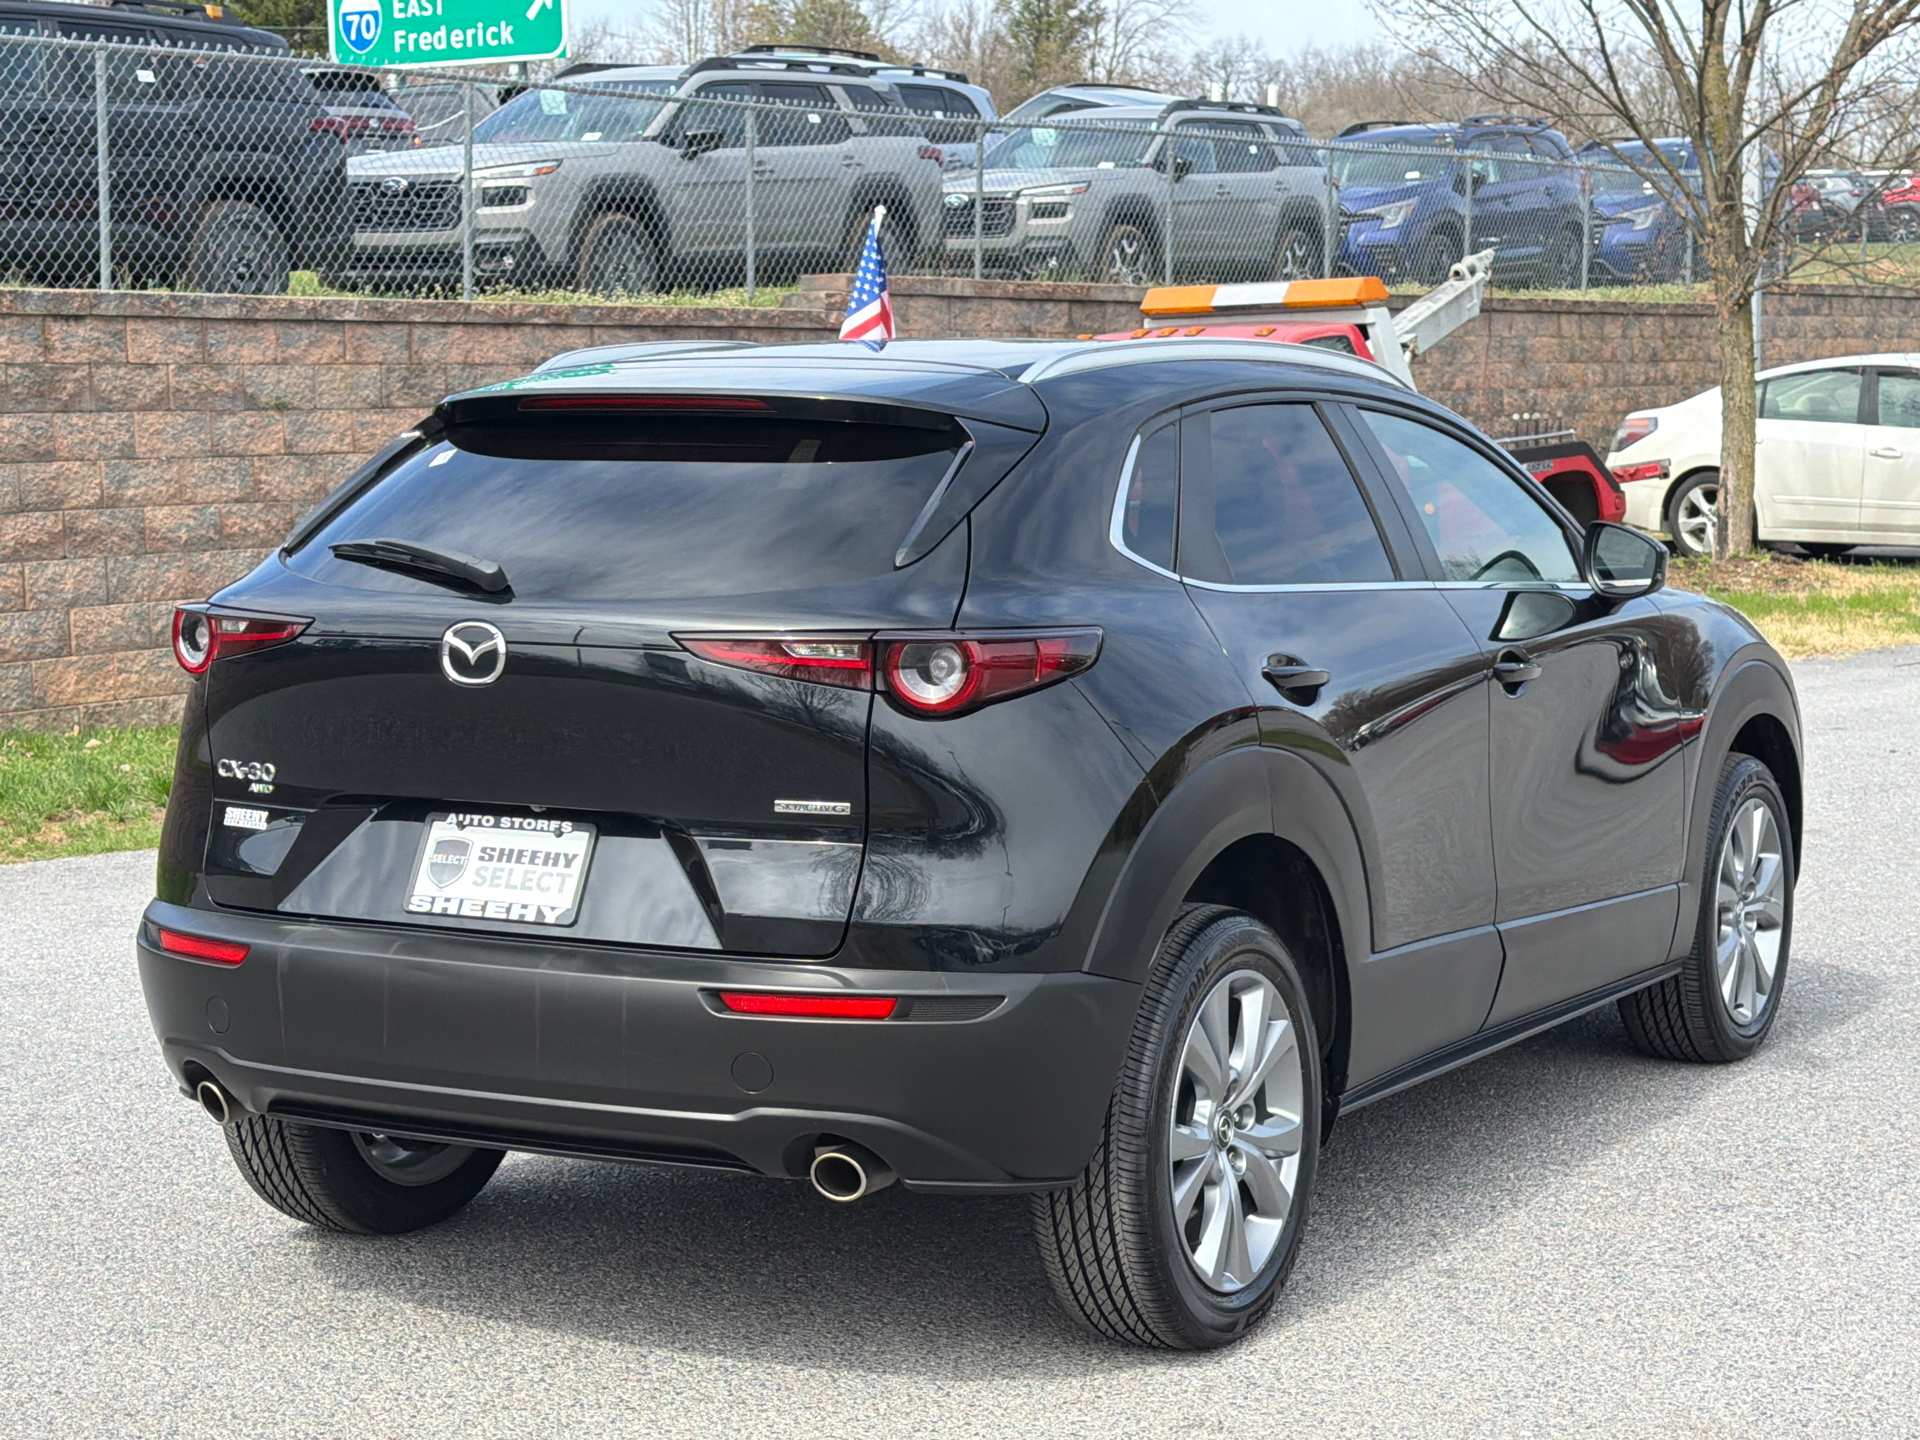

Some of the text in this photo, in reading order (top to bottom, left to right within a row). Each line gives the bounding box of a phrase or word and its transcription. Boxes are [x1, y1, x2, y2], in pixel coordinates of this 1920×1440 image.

[346, 13, 375, 41] 70
[394, 20, 514, 52] Frederick
[446, 813, 495, 827] AUTO
[431, 853, 467, 866] SELECT
[478, 847, 579, 868] SHEEHY
[471, 866, 574, 894] SELECT
[408, 895, 569, 923] SHEEHY
